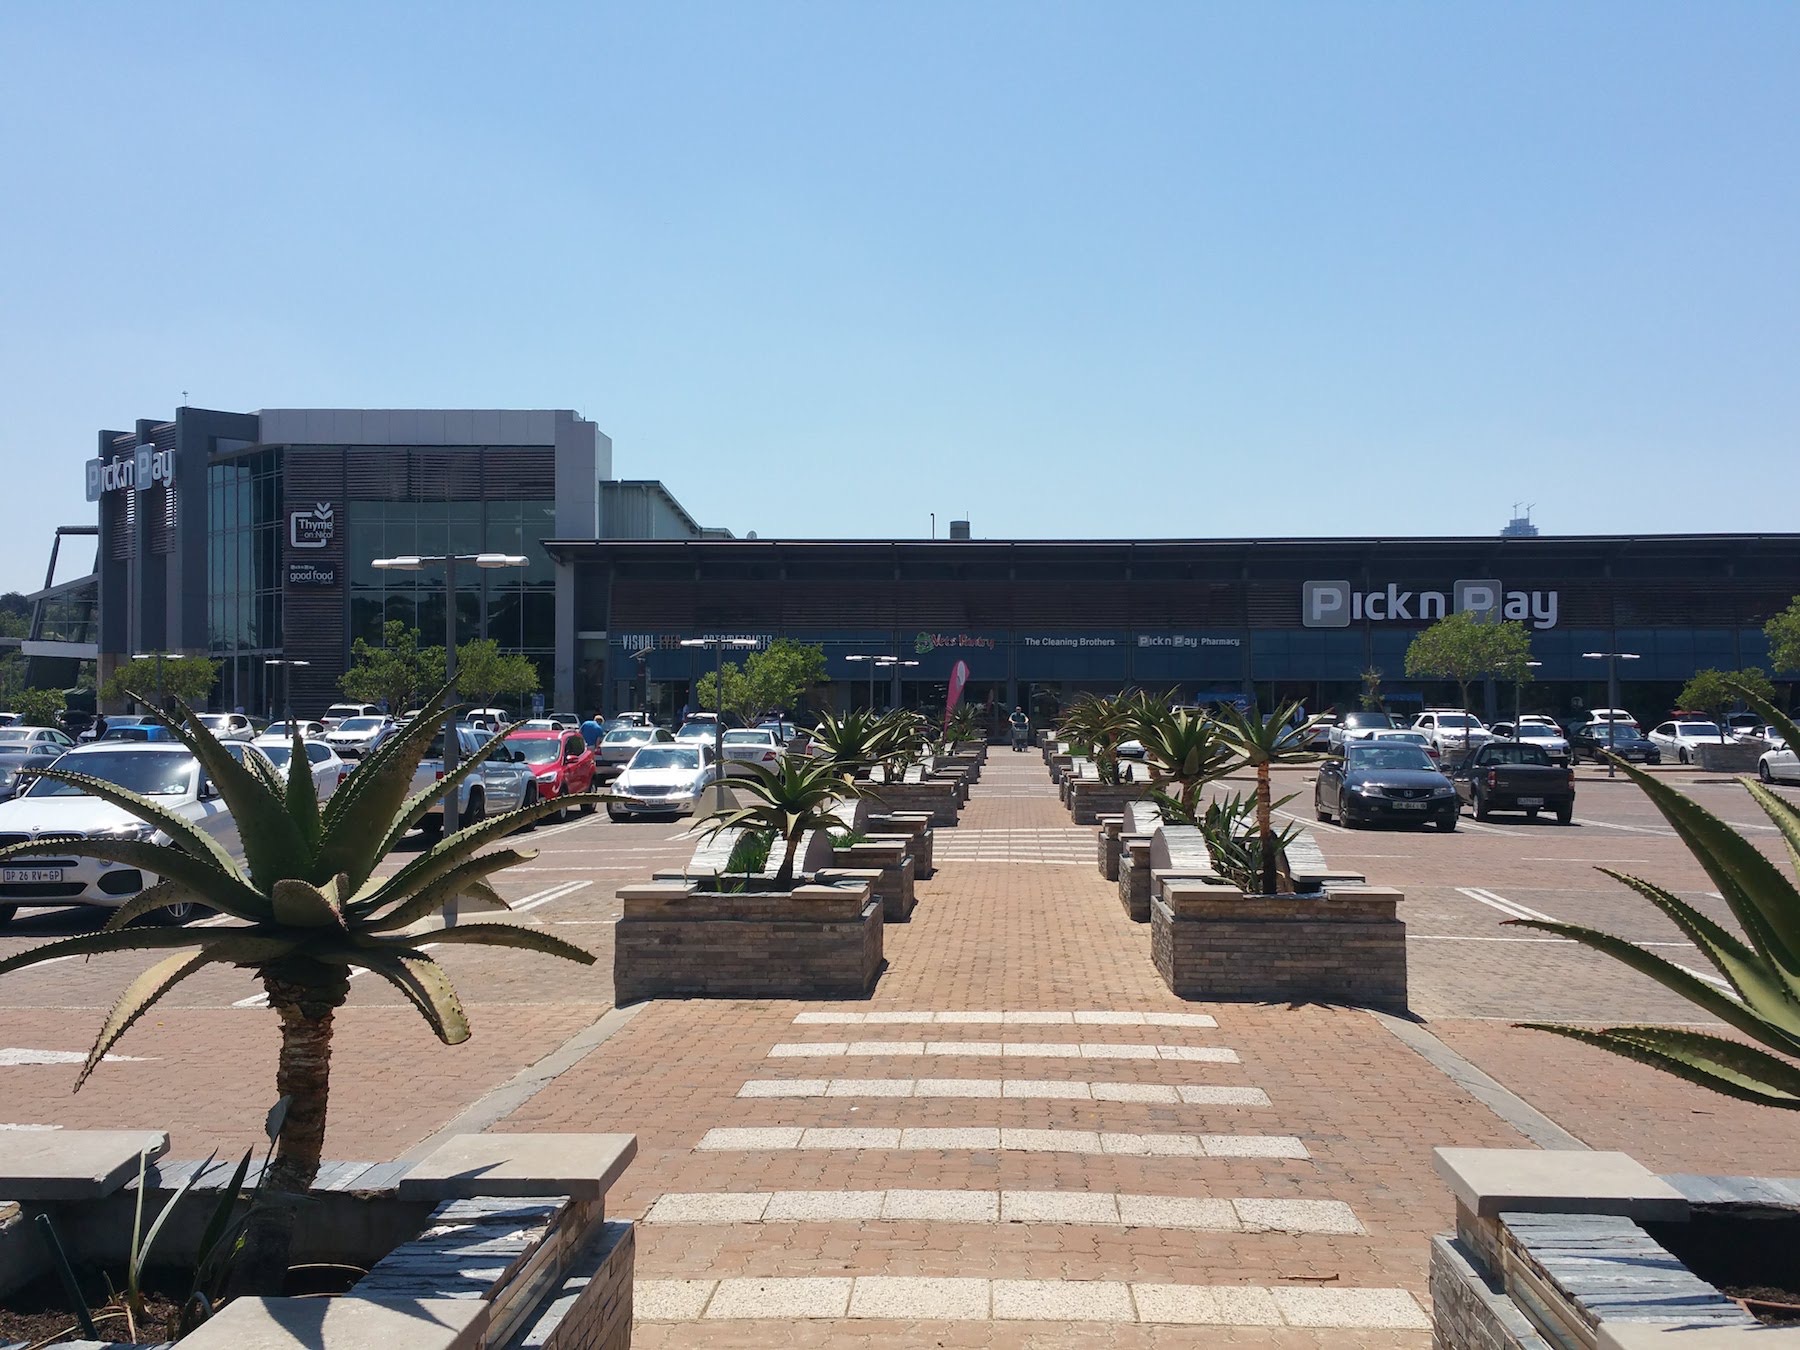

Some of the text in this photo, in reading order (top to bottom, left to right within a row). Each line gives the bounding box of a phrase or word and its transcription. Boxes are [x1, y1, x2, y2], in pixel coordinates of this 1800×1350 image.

[86, 455, 123, 502] Pick
[135, 443, 175, 491] Pay
[298, 519, 333, 531] Thyme
[315, 530, 334, 539] Nicol
[290, 571, 311, 583] good
[312, 570, 333, 580] food
[1303, 579, 1558, 629] Pick n Pay
[622, 635, 654, 650] VISUAL
[1025, 637, 1115, 648] The Cleaning Brothers
[1138, 635, 1163, 647] Pick
[1173, 635, 1197, 647] Pay
[1201, 637, 1240, 647] Pharmacy
[19, 871, 28, 881] 26
[32, 871, 42, 881] RV
[49, 870, 60, 880] GP
